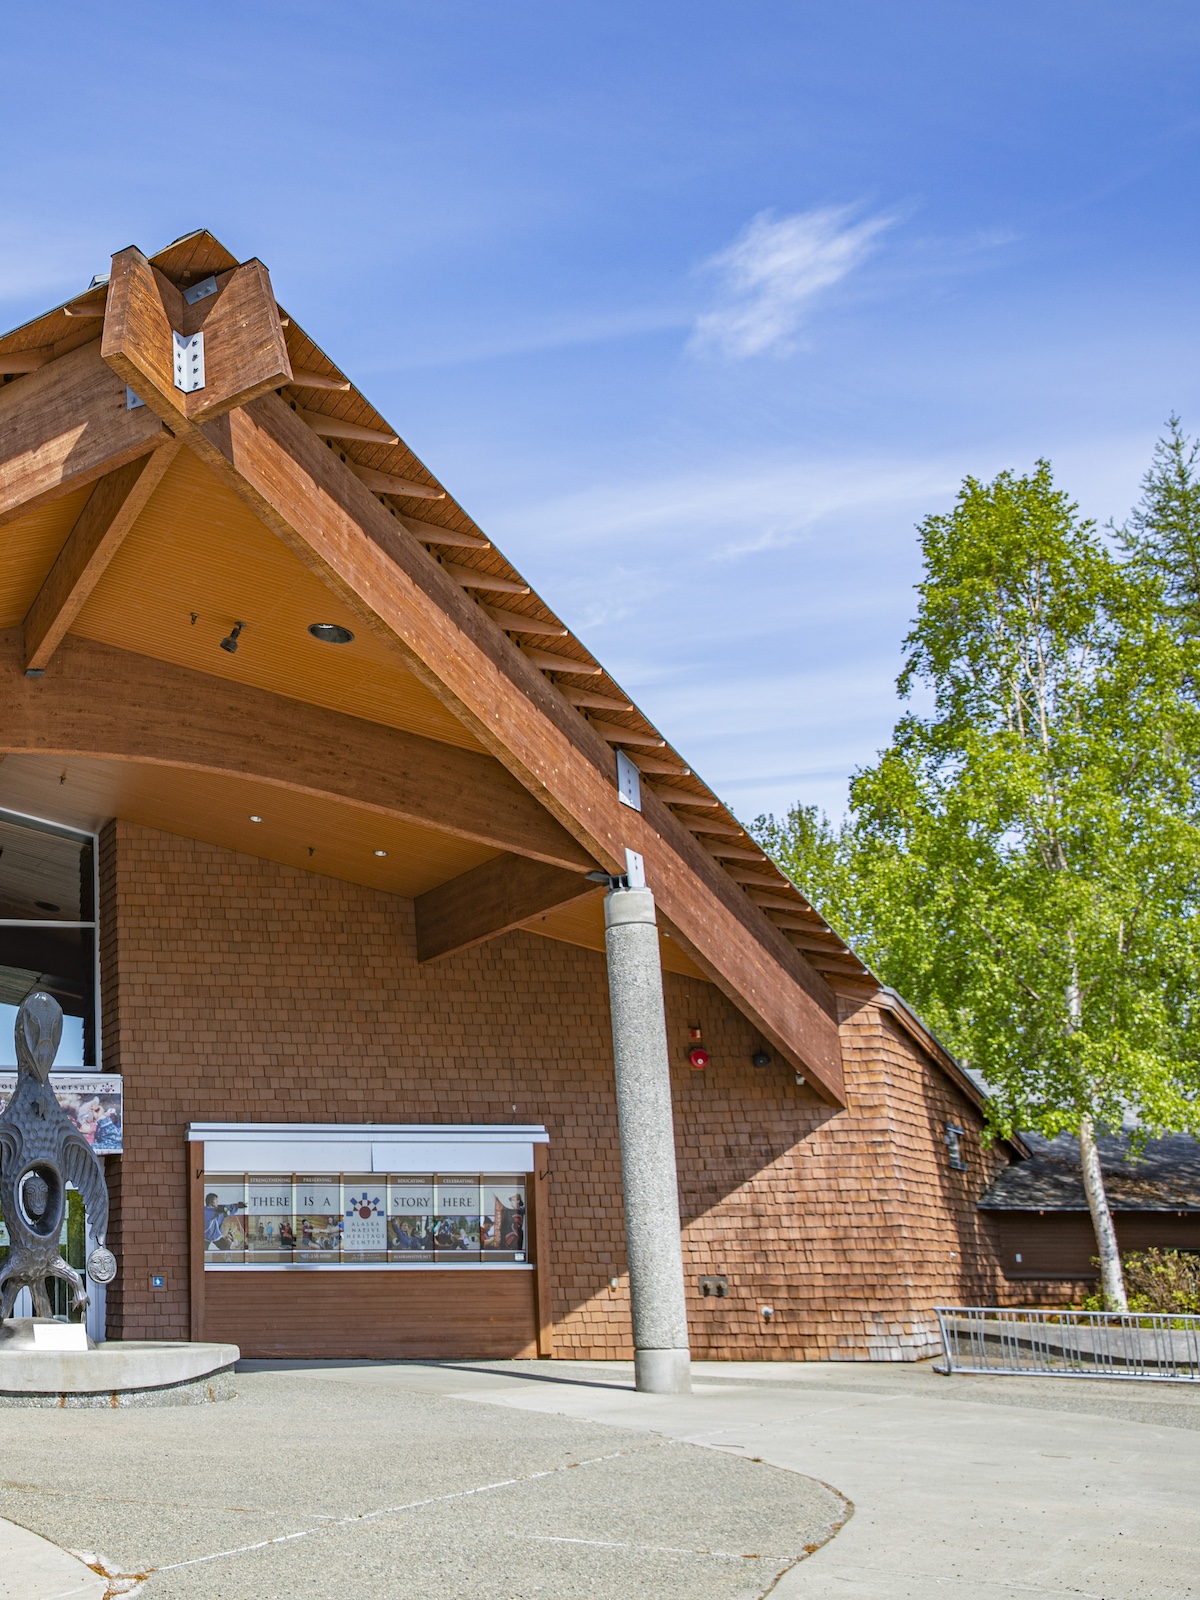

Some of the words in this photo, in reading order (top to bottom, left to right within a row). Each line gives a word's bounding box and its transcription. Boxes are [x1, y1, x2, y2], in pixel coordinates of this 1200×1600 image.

[251, 1196, 290, 1207] THERE
[304, 1196, 314, 1207] IS
[323, 1197, 331, 1207] A
[393, 1197, 431, 1208] STORY
[443, 1197, 475, 1208] HERE.
